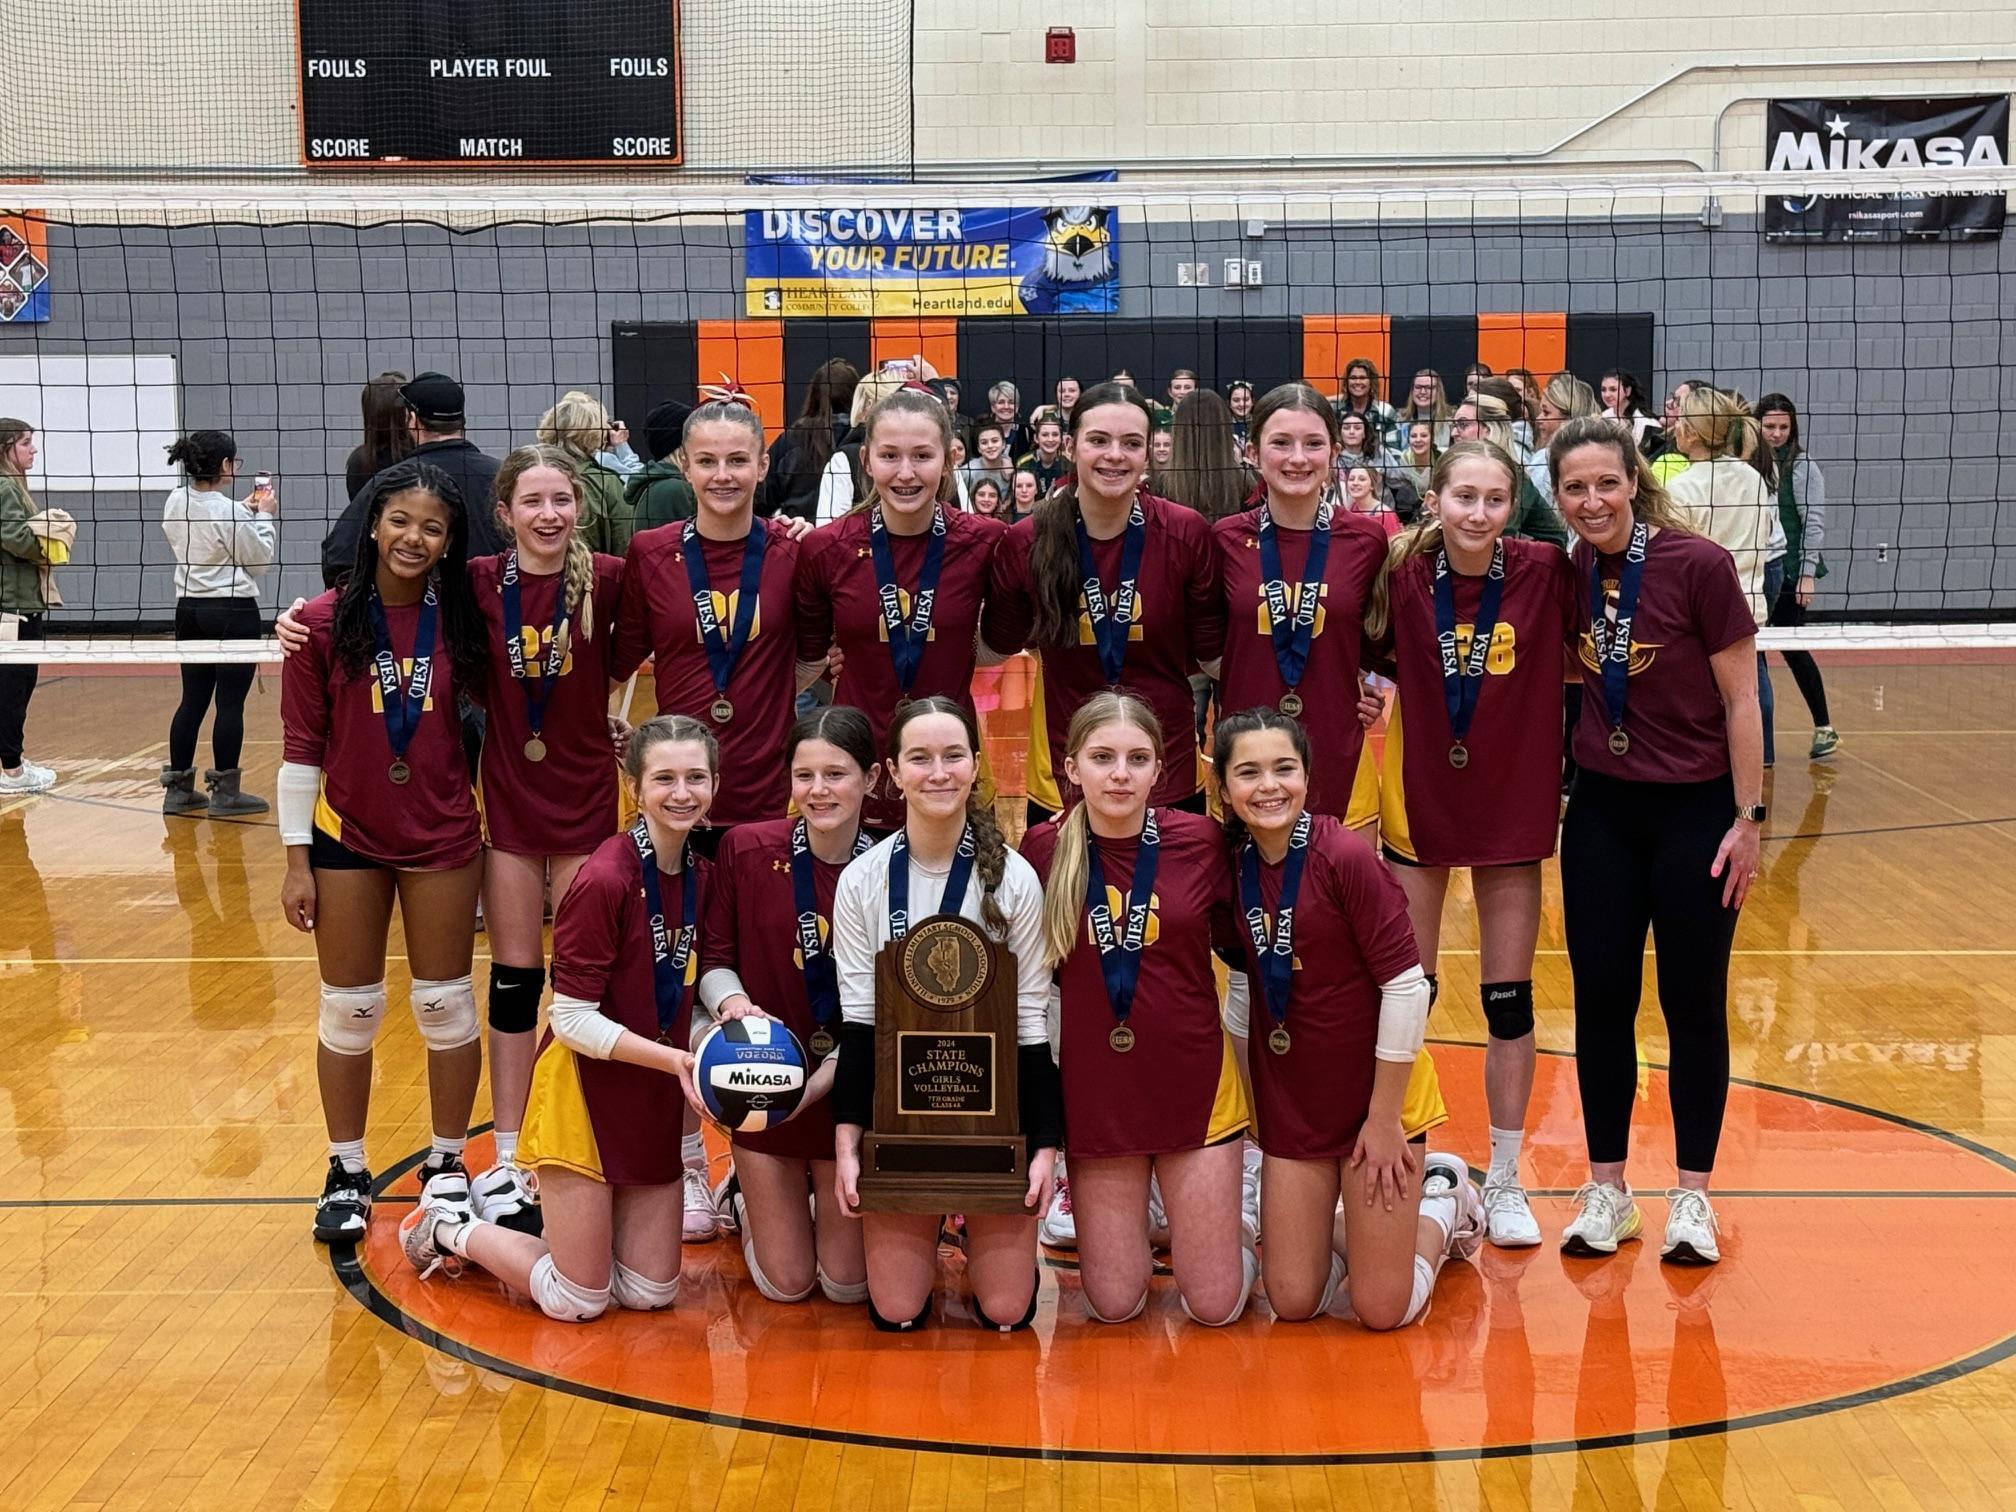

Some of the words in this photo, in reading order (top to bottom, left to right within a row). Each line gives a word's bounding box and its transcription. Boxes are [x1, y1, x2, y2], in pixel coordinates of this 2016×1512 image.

[308, 59, 367, 78] FOULS
[430, 59, 499, 78] PLAYER
[505, 59, 551, 78] FOUL
[610, 58, 668, 77] FOULS
[311, 139, 370, 157] SCORE
[459, 138, 523, 157] MATCH
[612, 137, 671, 156] SCORE
[763, 209, 962, 240] DISCOVER
[808, 245, 885, 271] YOUR
[892, 244, 1017, 271] FUTURE.
[786, 287, 880, 299] HEARTLAND
[912, 296, 1011, 310] Heartland.edu
[1632, 523, 1647, 553] IESA
[883, 594, 901, 630] IESA
[915, 590, 934, 622] IESA
[1087, 588, 1105, 624] IESA
[1118, 579, 1134, 613] IESA
[1270, 592, 1286, 626] IESA
[1299, 583, 1319, 617] IESA
[697, 602, 717, 634] IESA
[1613, 617, 1631, 650] IESA
[507, 636, 523, 669] IESA
[1441, 640, 1458, 678] IESA
[1470, 633, 1490, 668] IESA
[380, 661, 397, 695] IESA
[412, 656, 430, 690] IESA
[1095, 916, 1115, 955] IESA
[1126, 904, 1146, 941] IESA
[1250, 919, 1268, 957] IESA
[1277, 908, 1292, 945] IESA
[653, 924, 668, 963] IESA
[679, 925, 694, 958] IESA
[802, 922, 820, 960] IESA
[926, 1049, 966, 1060] STATE
[937, 1039, 955, 1047] 2024
[908, 1061, 985, 1078] CHAMPIONS
[931, 1075, 962, 1084] GIRLS
[913, 1084, 980, 1093] VOLLEYBALL
